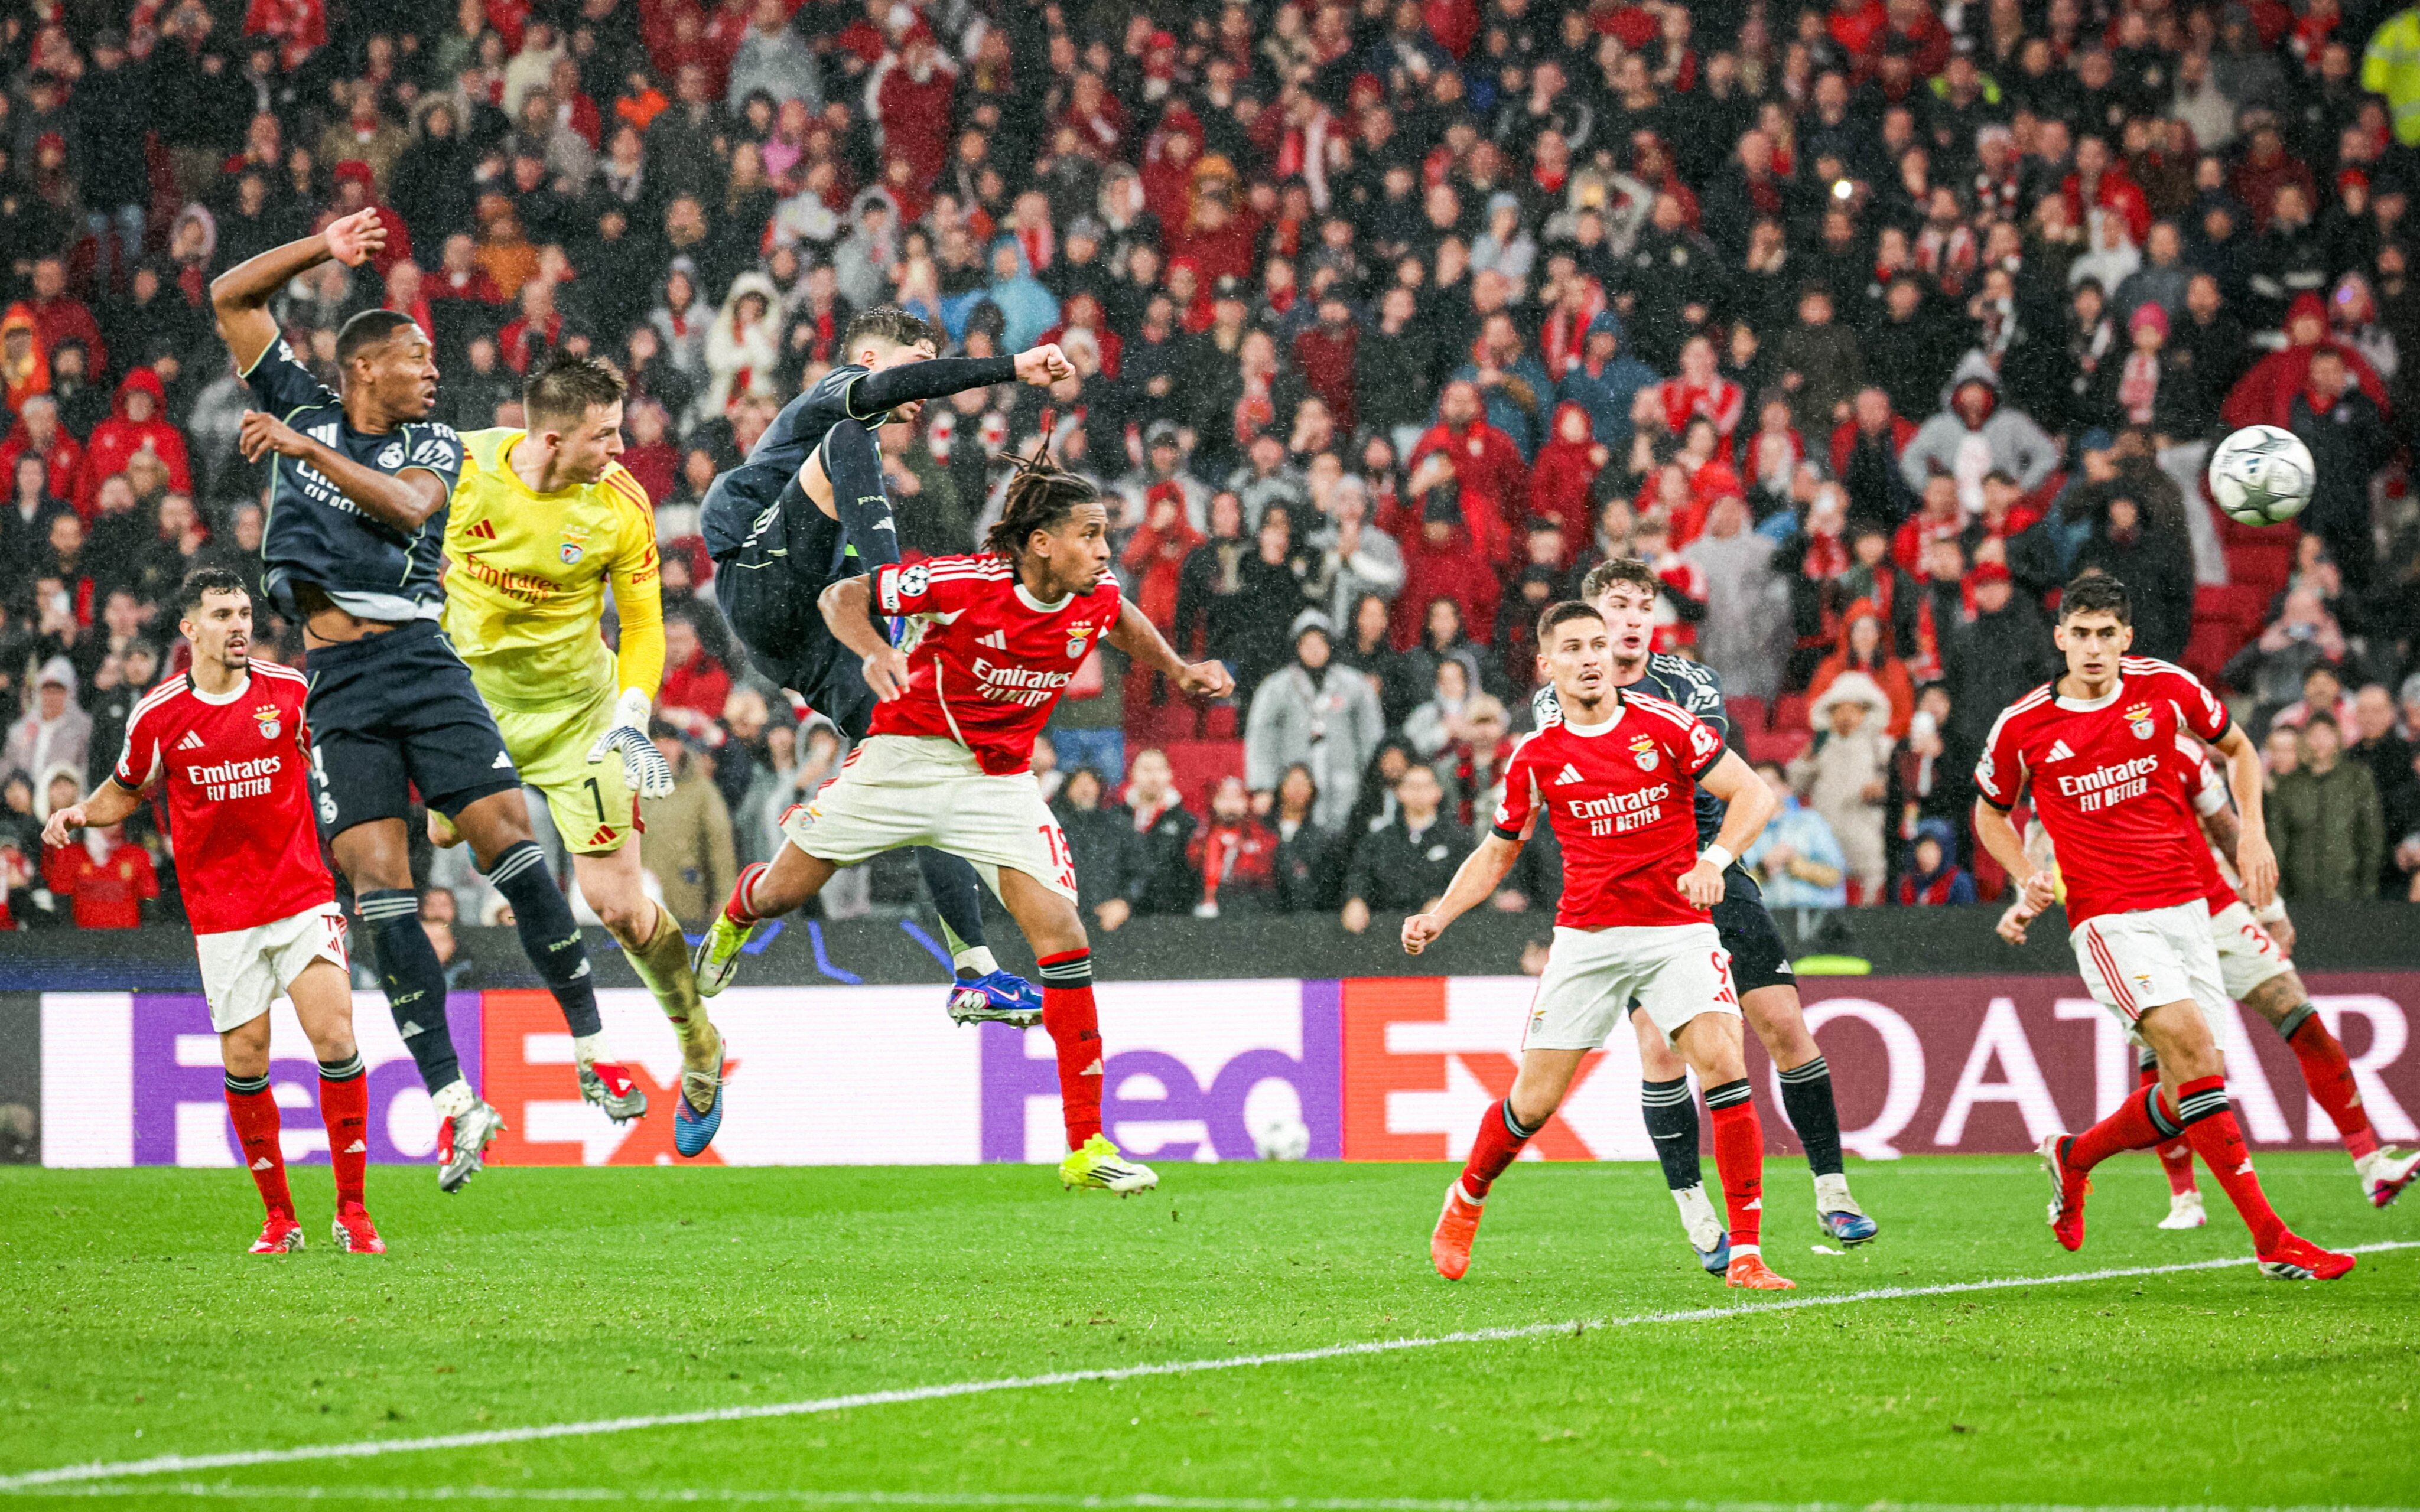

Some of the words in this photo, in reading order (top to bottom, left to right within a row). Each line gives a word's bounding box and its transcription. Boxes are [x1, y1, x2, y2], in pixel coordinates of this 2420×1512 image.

[467, 552, 563, 592] Emirates
[971, 657, 1073, 689] Emirates
[187, 755, 281, 785] Emirates
[2058, 754, 2159, 796] Emirates
[207, 784, 226, 801] FLY
[229, 777, 272, 799] BETTER
[584, 777, 606, 822] 1
[1567, 783, 1670, 819] Emirates
[2080, 791, 2102, 812] FLY
[2105, 777, 2148, 807] BETTER
[1590, 818, 1612, 836] FLY
[1616, 804, 1662, 832] BETTER
[1039, 825, 1074, 868] 18
[1712, 951, 1727, 985] 9
[133, 991, 743, 1167] FedEx
[981, 977, 1609, 1164] FedEx
